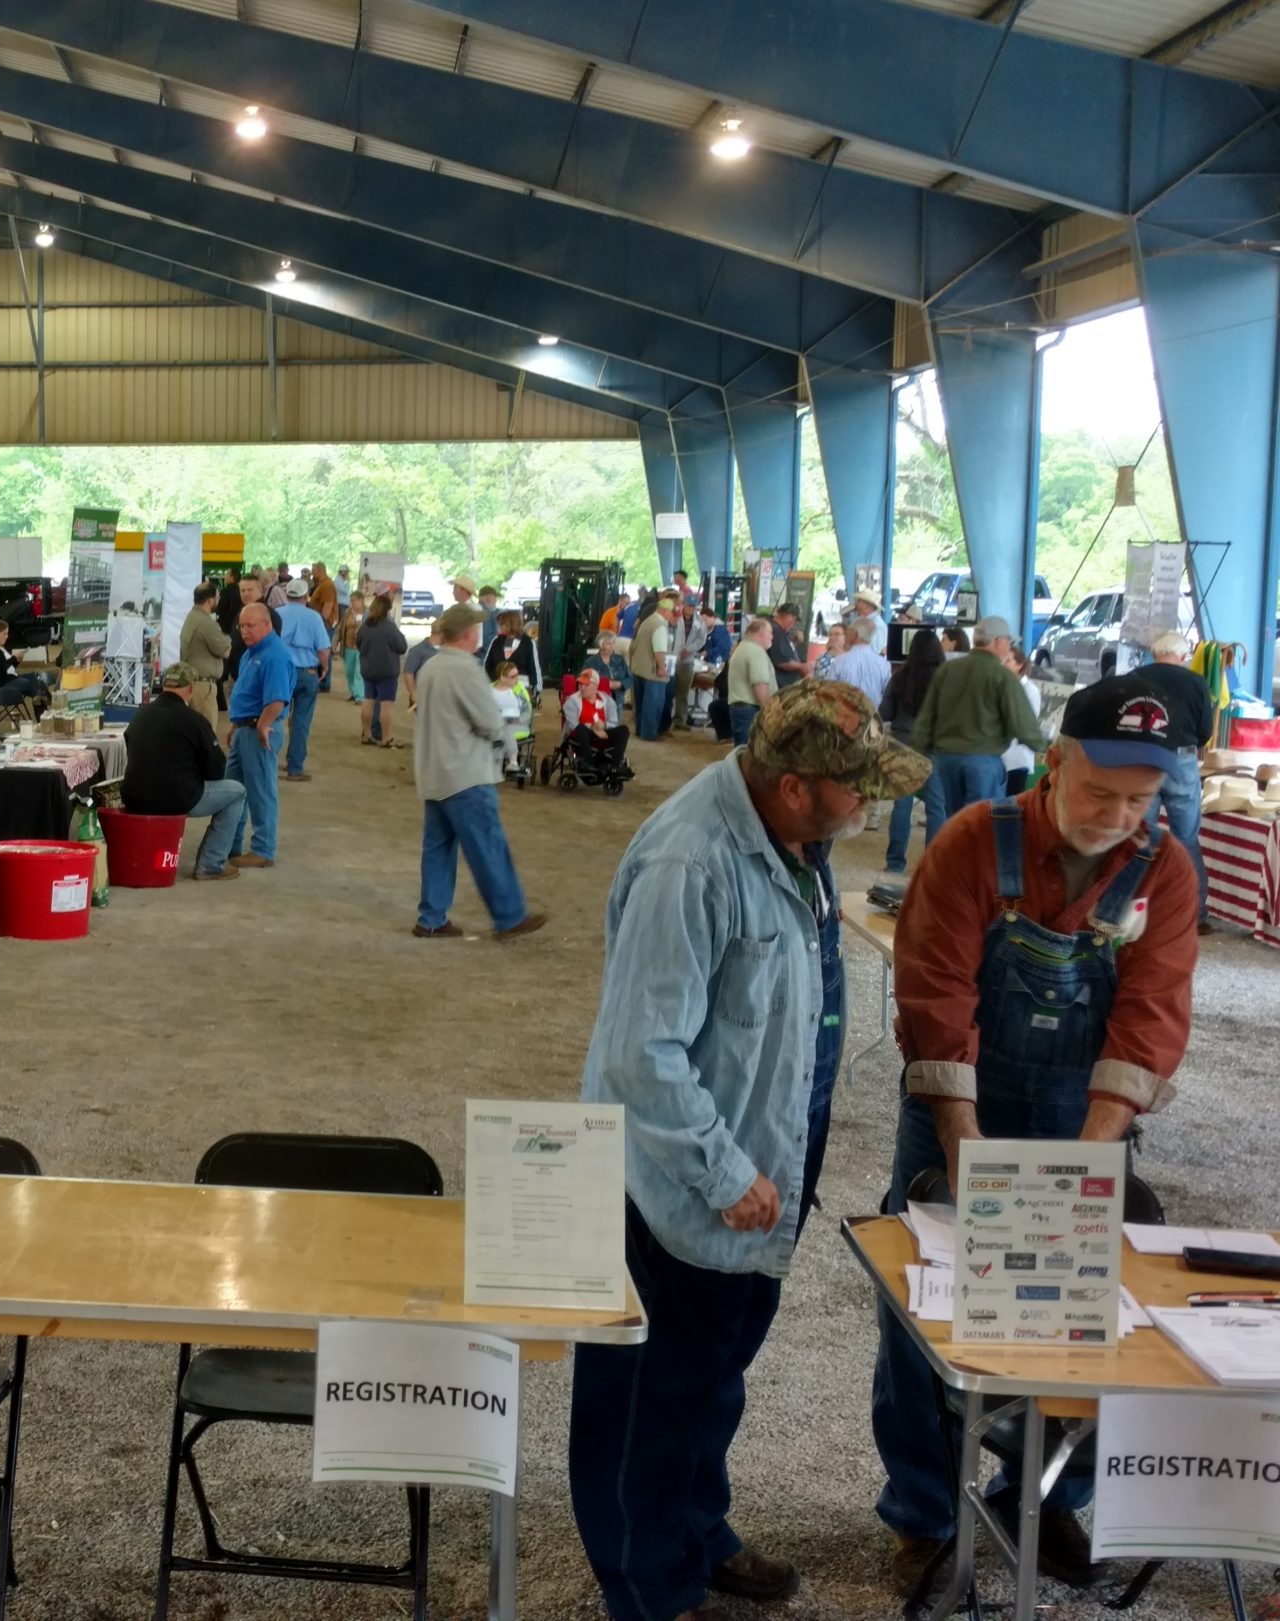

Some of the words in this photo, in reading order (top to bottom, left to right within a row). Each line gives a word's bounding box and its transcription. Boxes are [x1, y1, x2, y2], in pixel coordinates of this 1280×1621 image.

[972, 1201, 1000, 1210] CPC
[1073, 1223, 1109, 1235] zoetis
[326, 1381, 507, 1417] REGISTRATION
[1107, 1455, 1280, 1483] REGISTRATIO
